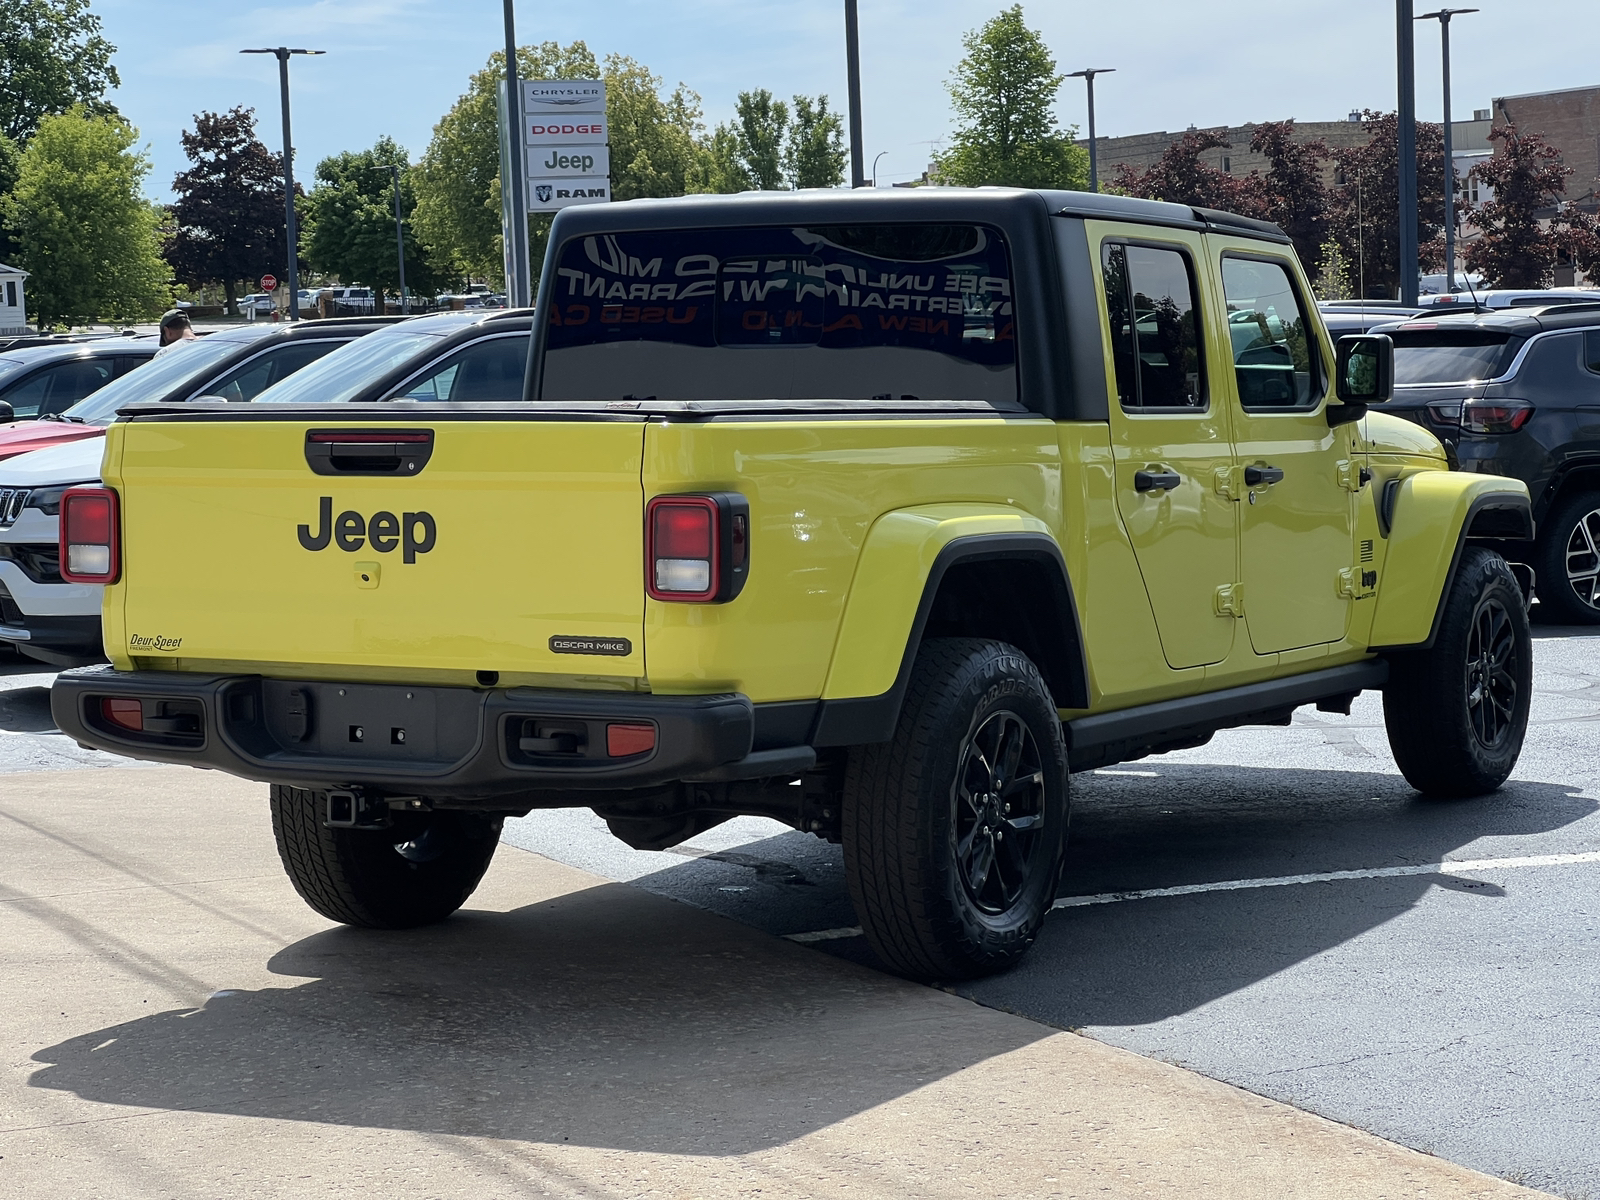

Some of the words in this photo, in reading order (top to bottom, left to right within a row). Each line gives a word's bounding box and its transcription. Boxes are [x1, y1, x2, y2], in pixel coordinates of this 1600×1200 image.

[531, 124, 603, 135] DODGE
[544, 151, 594, 172] Jeep
[556, 188, 606, 199] RAM
[297, 496, 437, 564] Jeep
[130, 633, 153, 645] Deur
[154, 634, 182, 650] Speet
[554, 641, 594, 650] OSCAR
[596, 643, 625, 651] MIKE
